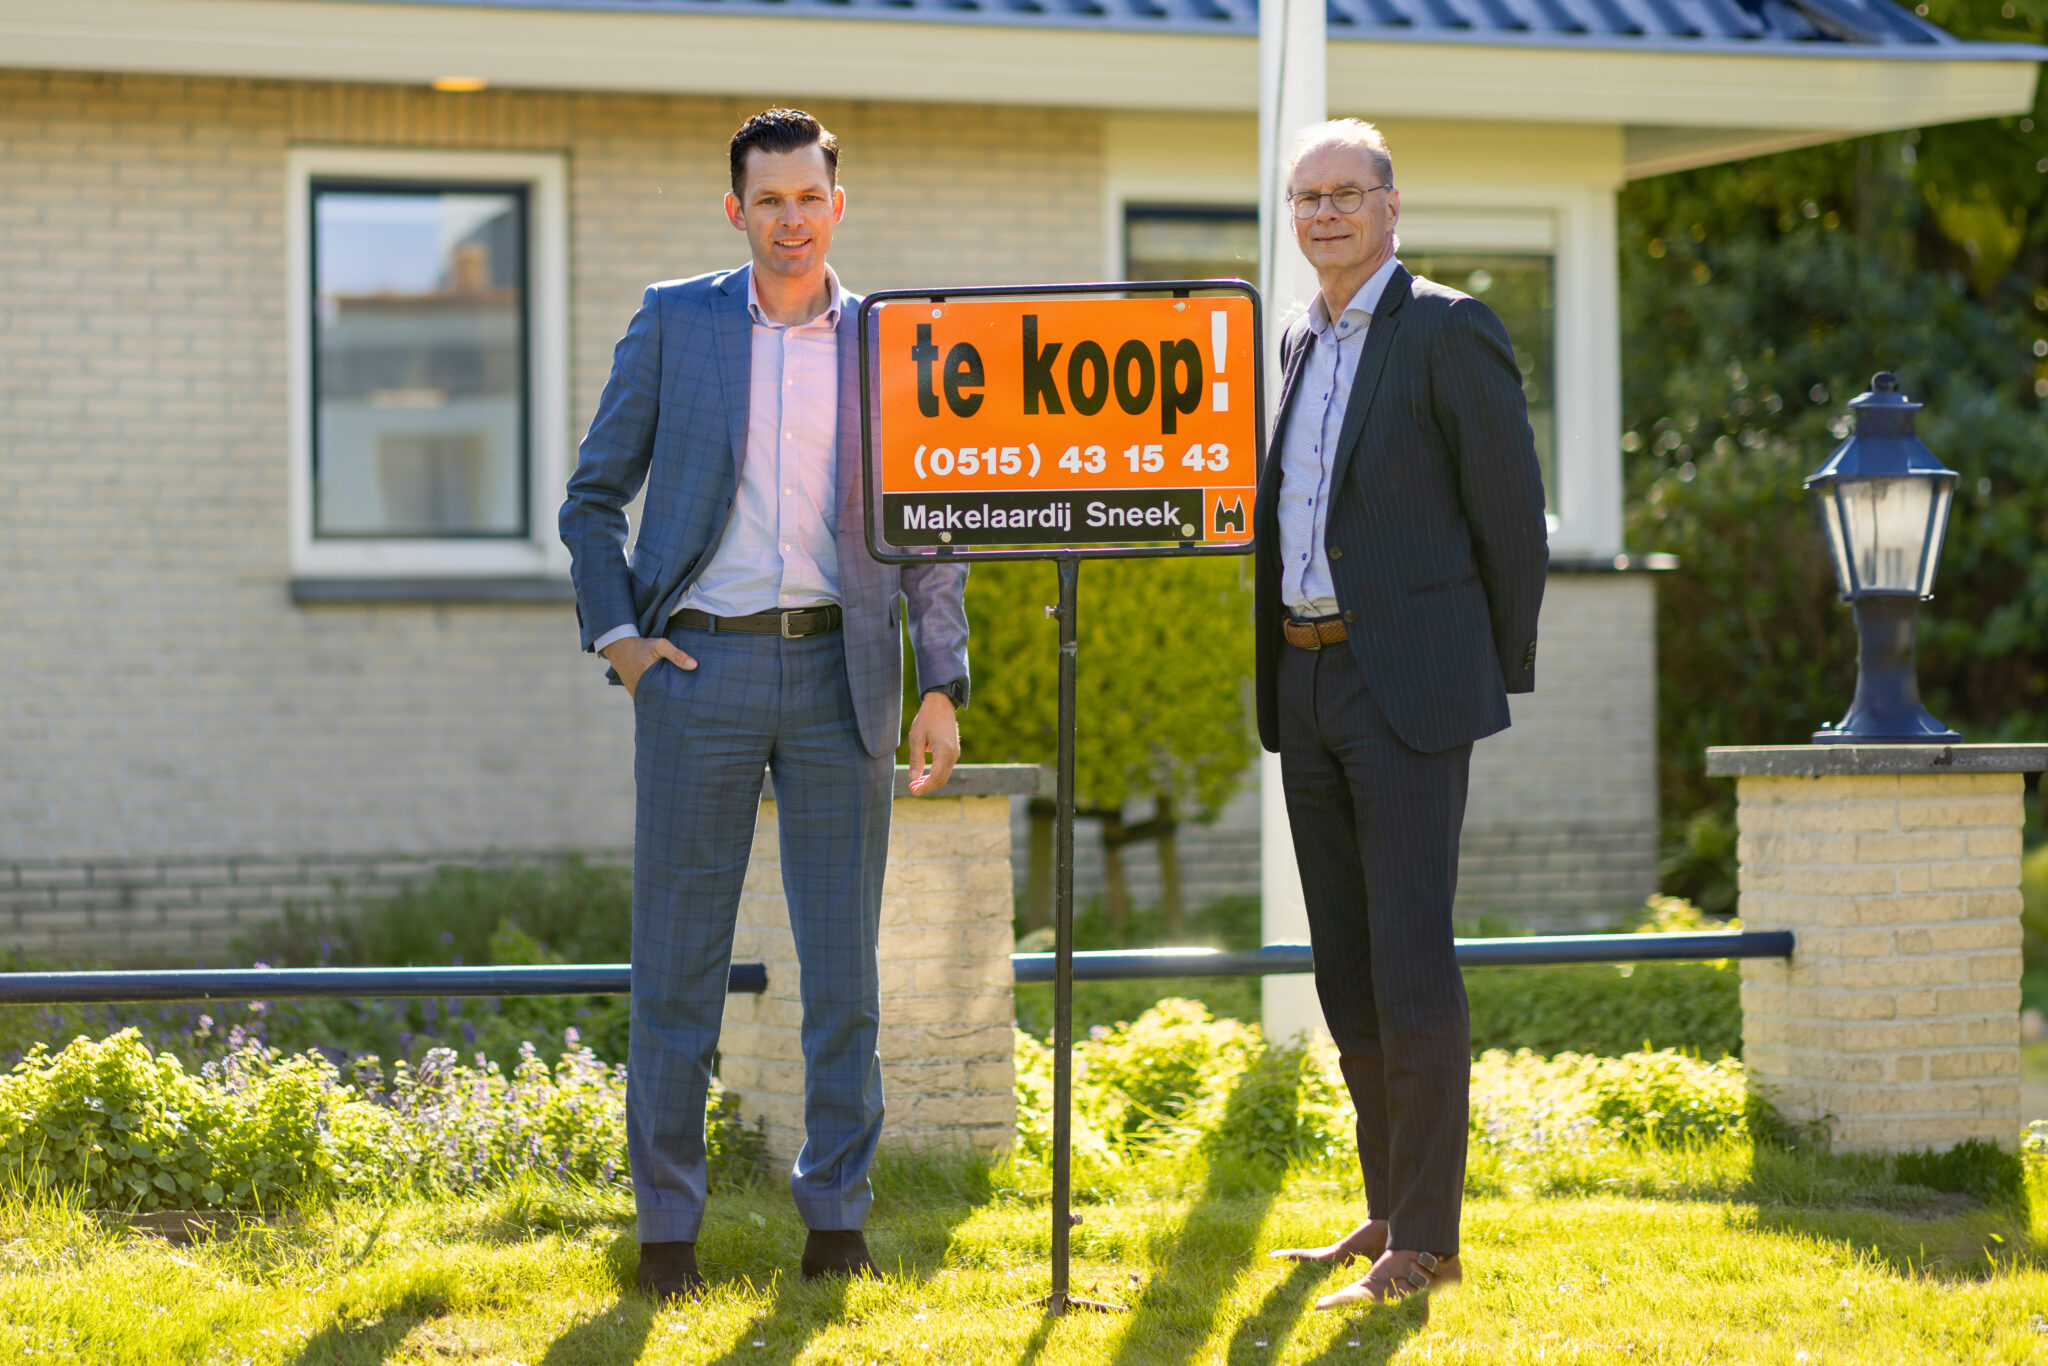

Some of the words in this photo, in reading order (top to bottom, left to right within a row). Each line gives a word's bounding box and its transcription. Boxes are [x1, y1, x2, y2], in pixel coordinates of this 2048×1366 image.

[911, 323, 985, 418] te
[1022, 311, 1229, 435] koop!
[913, 443, 1041, 480] (0515)
[1058, 445, 1107, 474] 43
[1123, 444, 1165, 473] 15
[1181, 443, 1230, 472] 43
[903, 502, 1072, 532] Makelaardij
[1086, 501, 1181, 528] Sneek
